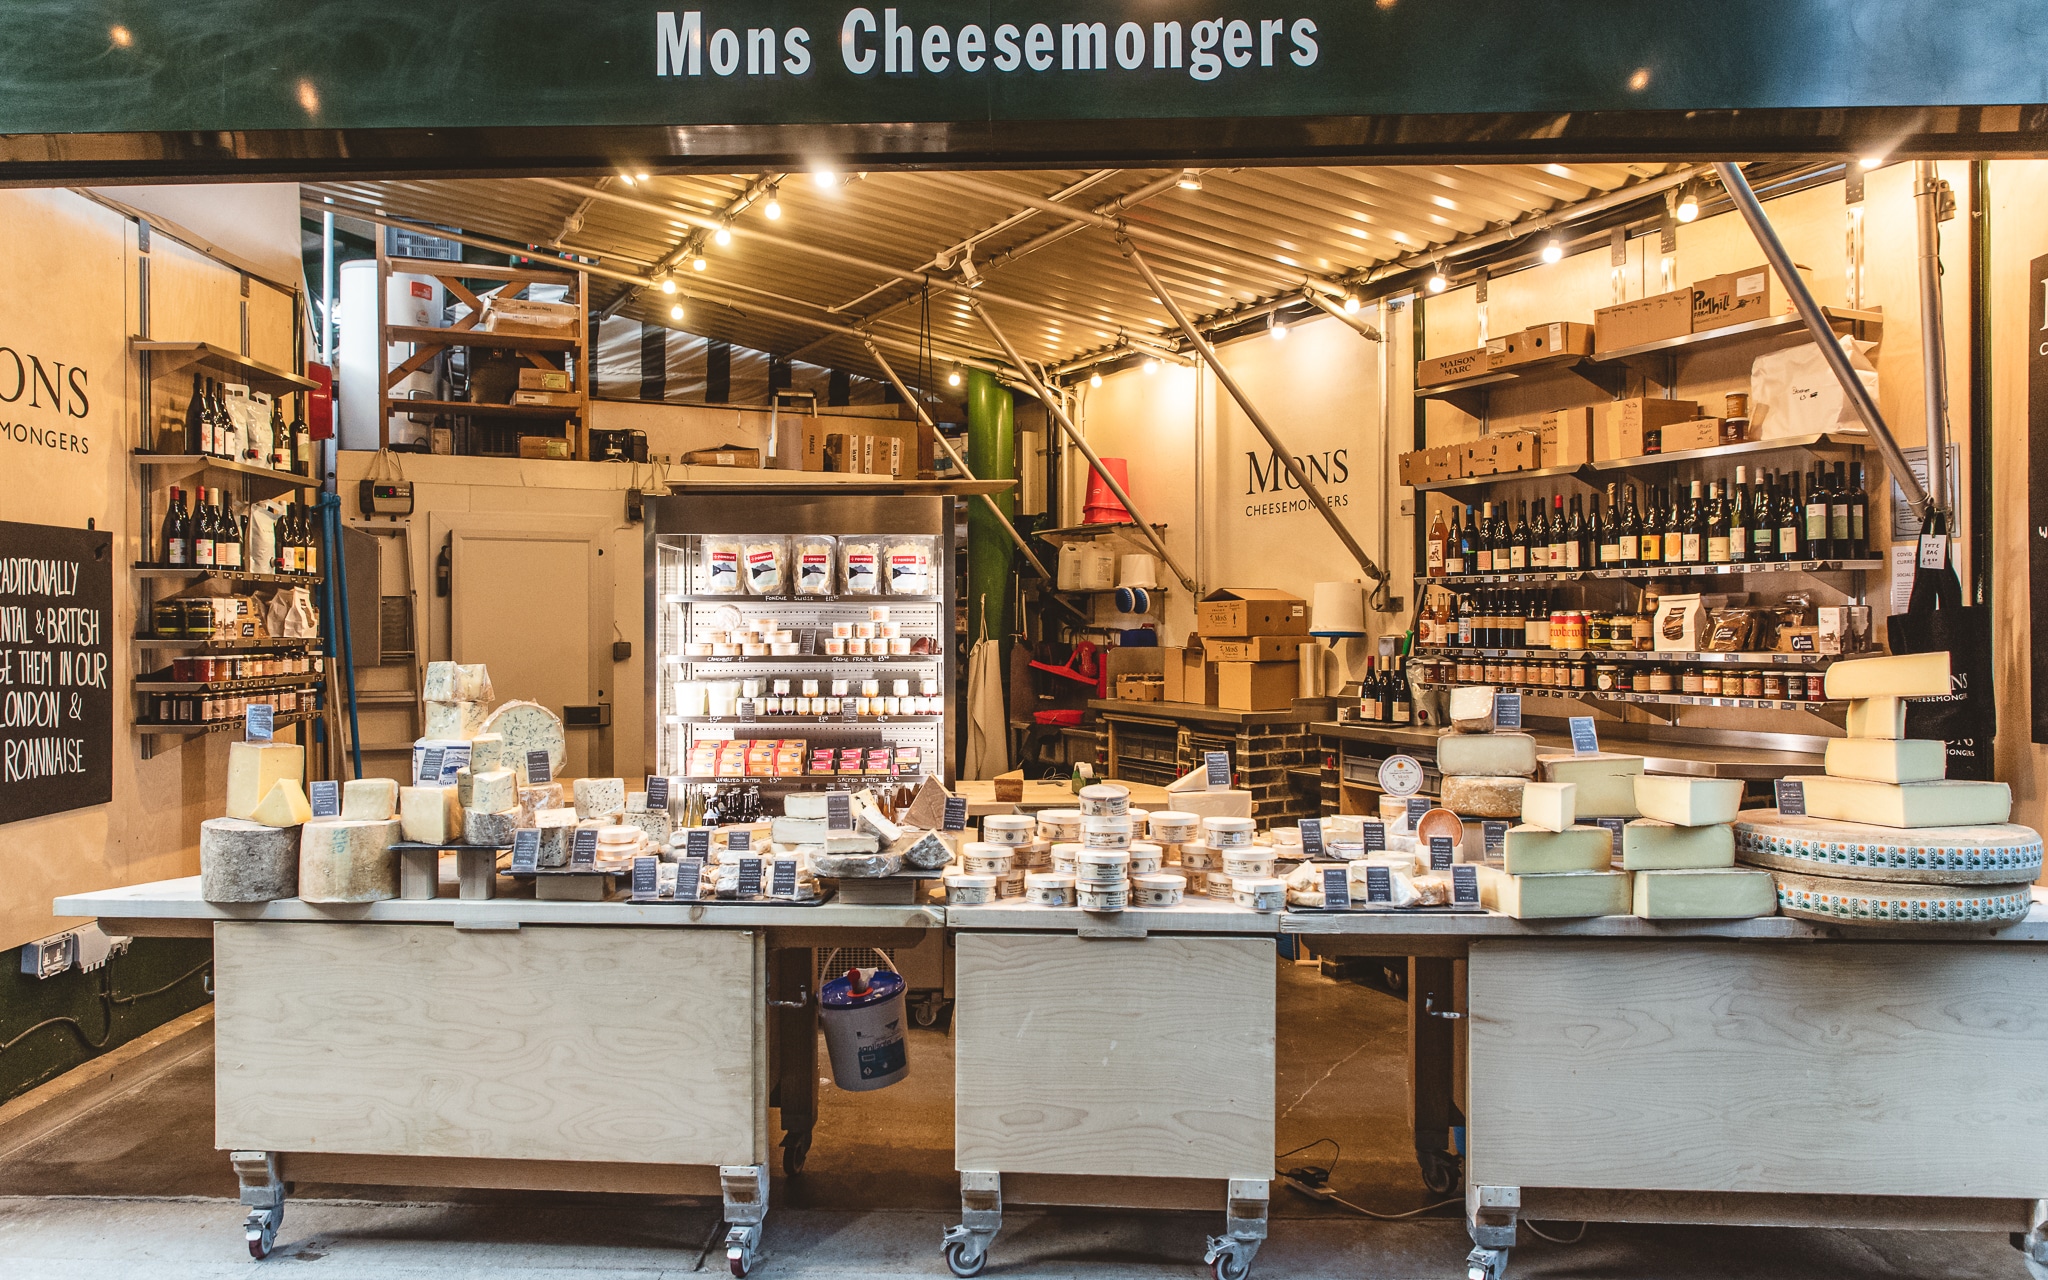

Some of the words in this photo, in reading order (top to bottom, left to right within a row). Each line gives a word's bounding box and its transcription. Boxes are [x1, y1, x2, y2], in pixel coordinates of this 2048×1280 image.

[656, 10, 812, 76] Mons
[840, 7, 1320, 81] Cheesemongers
[1439, 355, 1476, 370] MAISON
[1445, 364, 1471, 376] MARC
[1245, 448, 1349, 496] MONS
[1245, 493, 1349, 517] CHEESEMONERS
[0, 557, 80, 598] ADITIONALLY
[0, 606, 34, 645] NTAL
[35, 609, 46, 637] &
[47, 607, 100, 647] BRITISH
[18, 650, 53, 687] THEM
[59, 650, 73, 686] IN
[75, 652, 107, 690] OUR
[0, 690, 61, 729] ONDON
[68, 691, 83, 722] &
[4, 737, 87, 783] ROANNAISE
